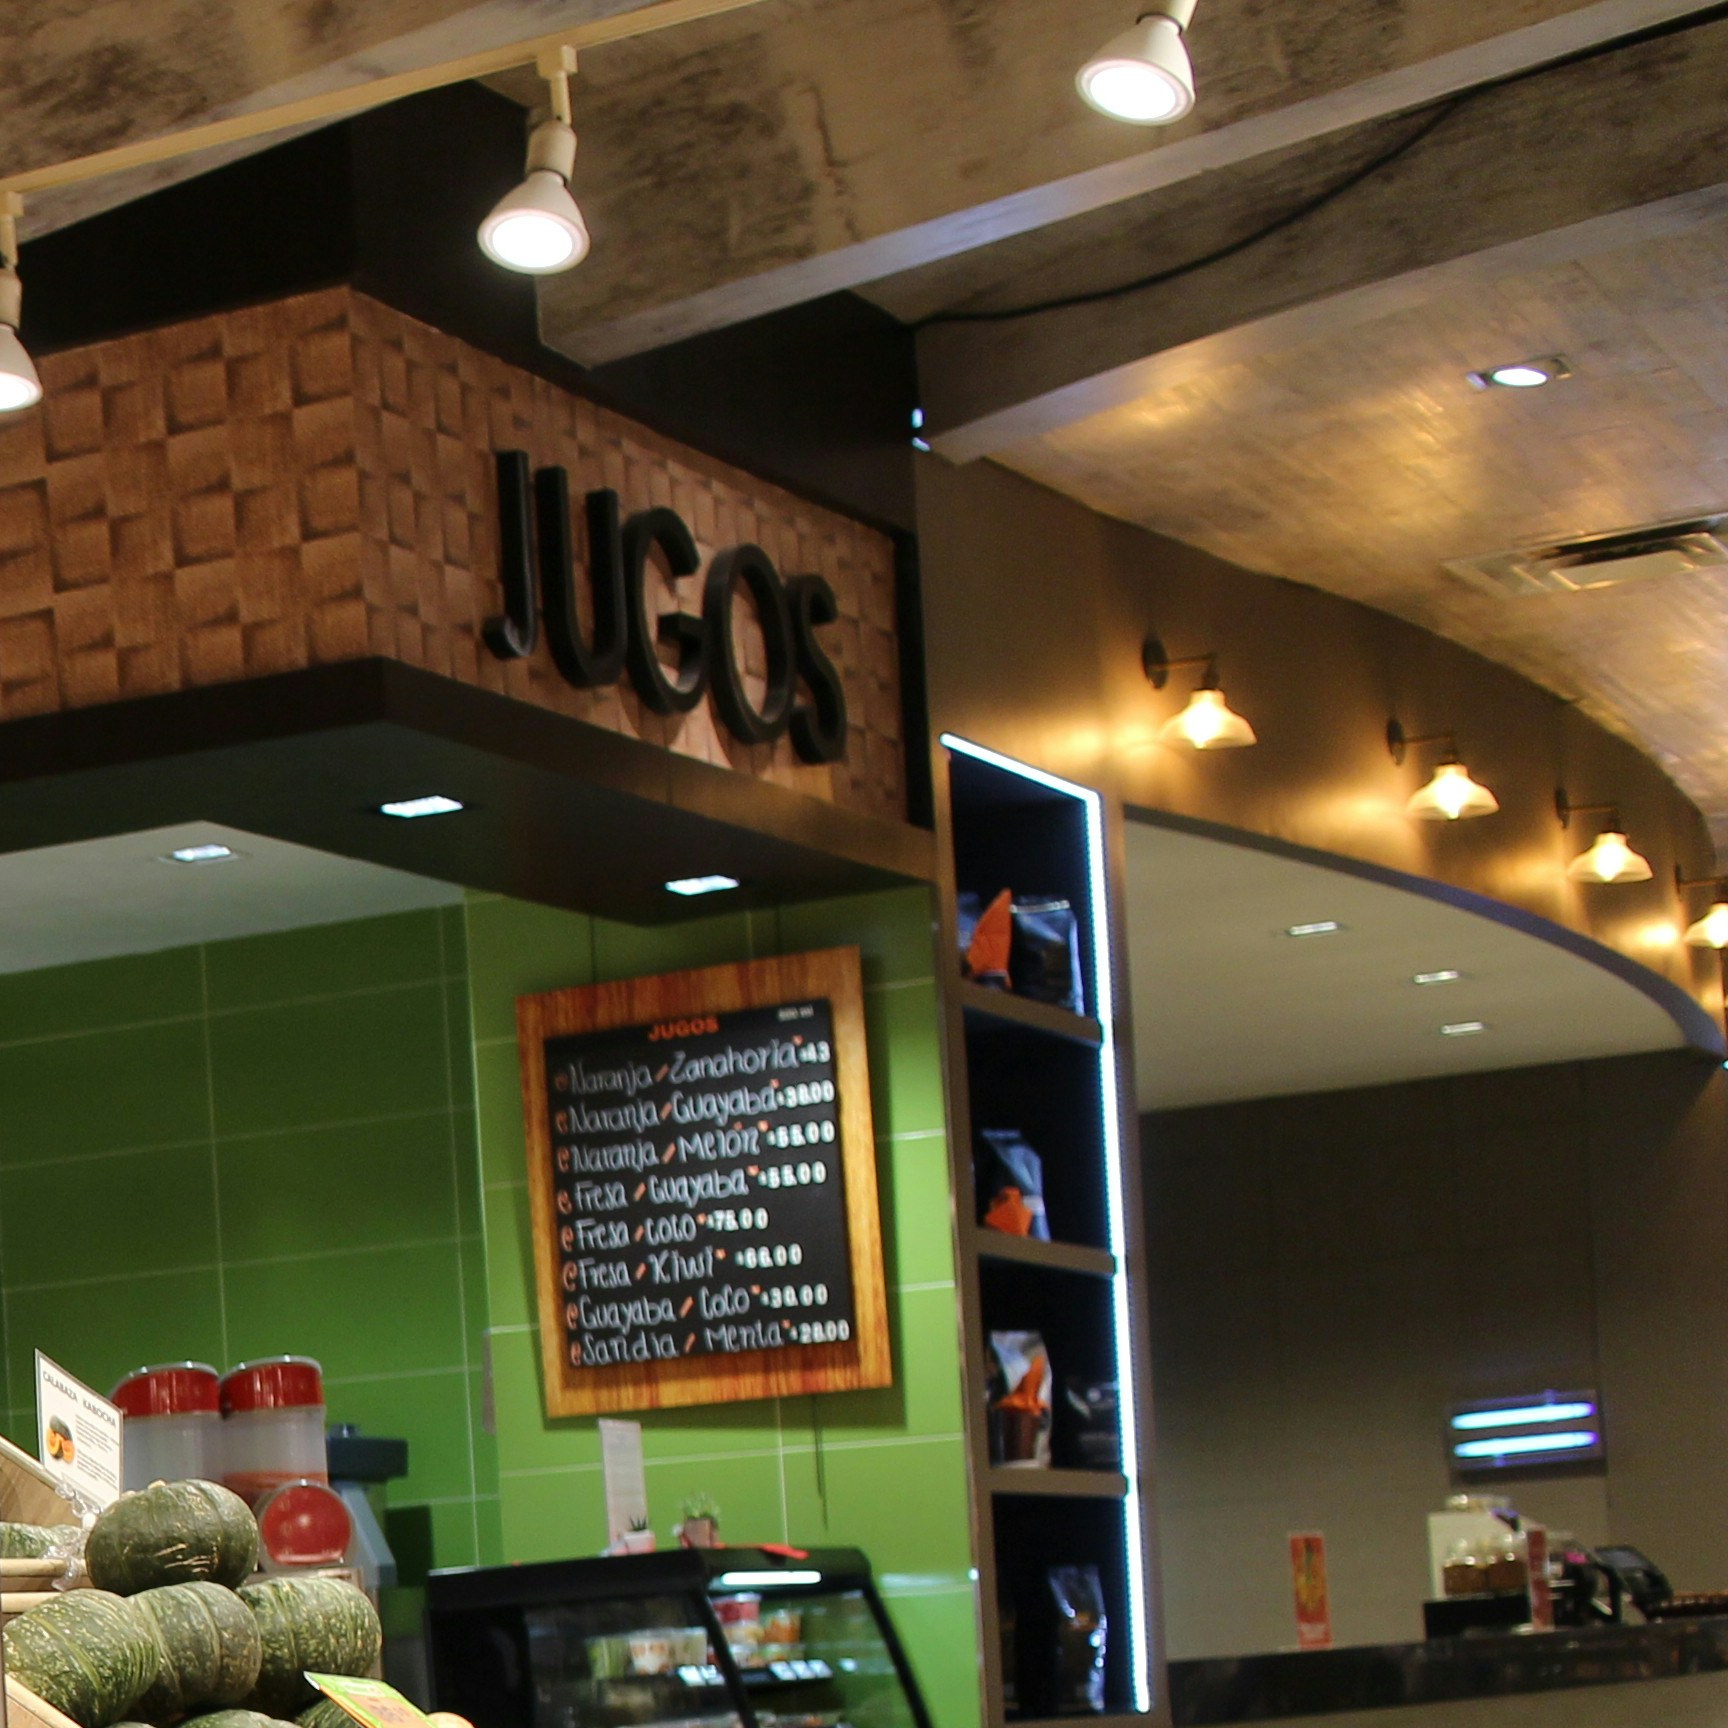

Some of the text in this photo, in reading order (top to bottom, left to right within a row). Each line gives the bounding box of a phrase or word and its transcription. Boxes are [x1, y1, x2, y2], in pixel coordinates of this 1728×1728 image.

[482, 450, 847, 764] JUGOS
[648, 1017, 719, 1042] JUGOS
[569, 1058, 653, 1097] Naranja
[669, 1038, 800, 1085] Zanahoria
[569, 1098, 660, 1135] Naranja
[671, 1084, 779, 1128] Guayaba
[570, 1138, 660, 1173] Naranja
[574, 1180, 630, 1212] Fresa
[647, 1168, 751, 1209] Guayaba
[575, 1217, 631, 1251] Fresa
[577, 1257, 633, 1290] Fresa
[579, 1294, 677, 1335] Guayaba
